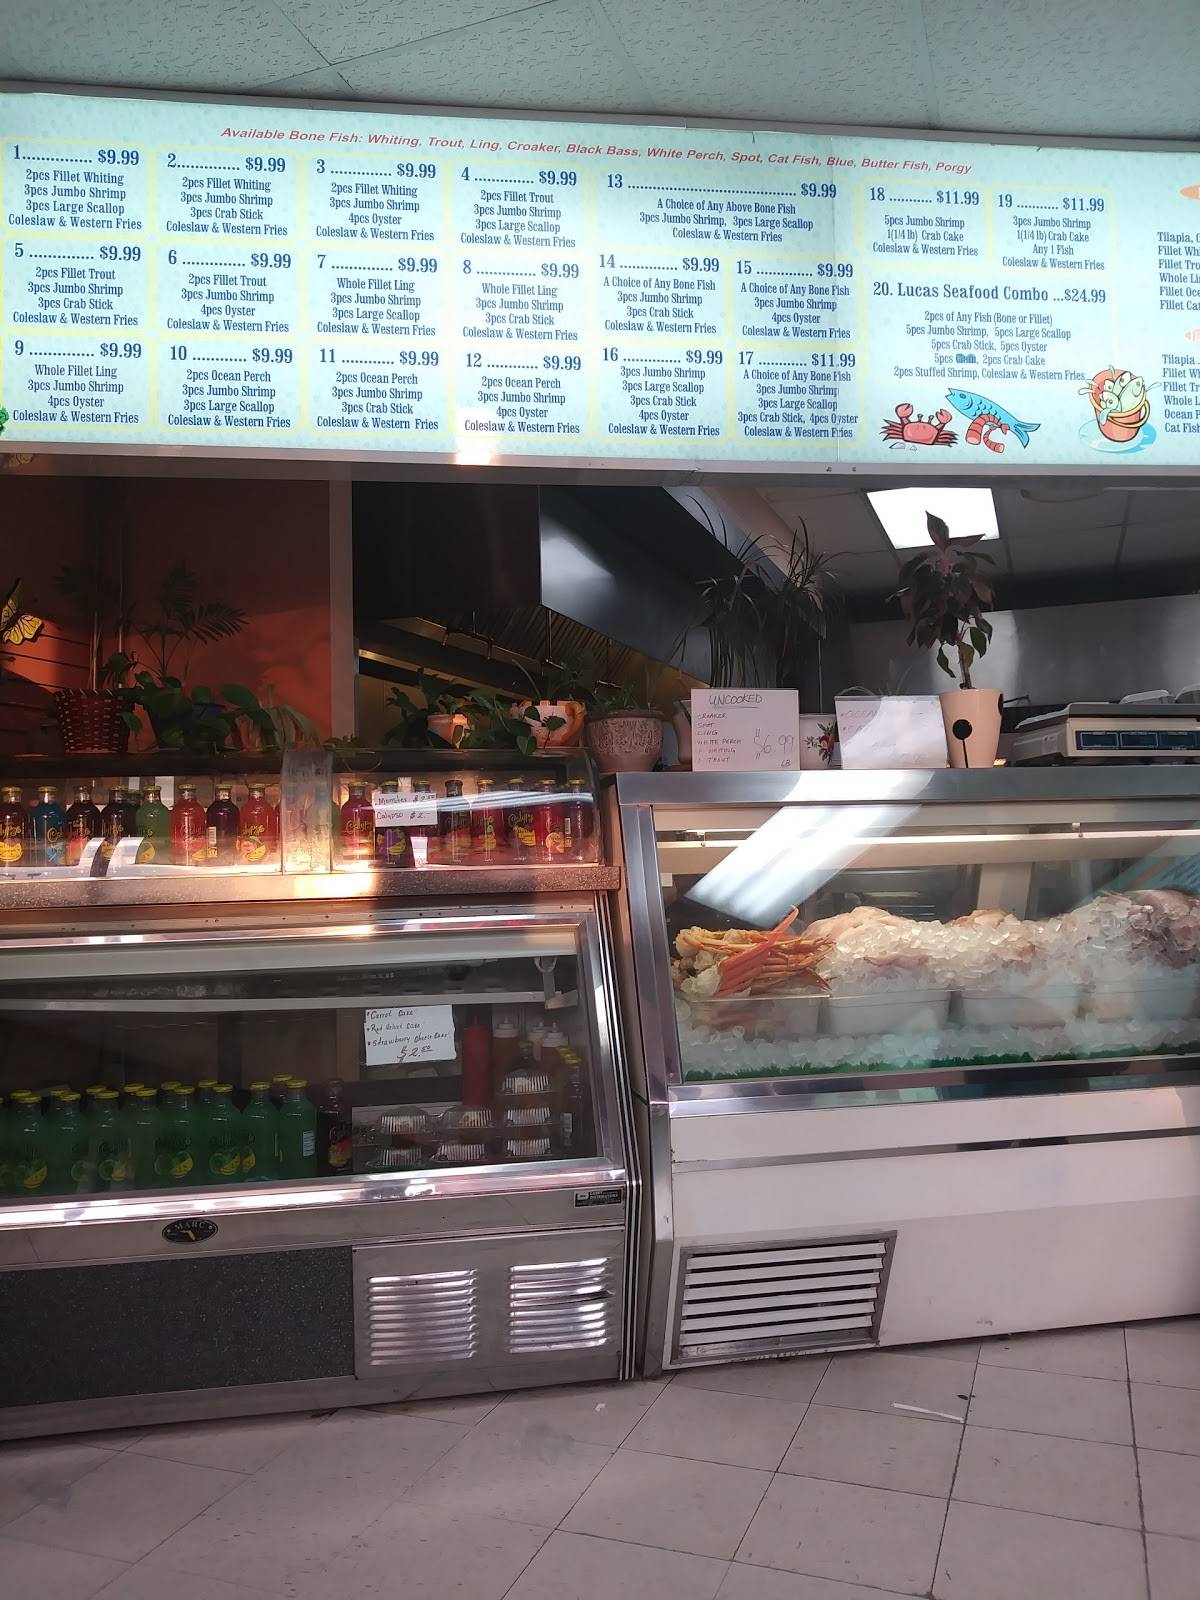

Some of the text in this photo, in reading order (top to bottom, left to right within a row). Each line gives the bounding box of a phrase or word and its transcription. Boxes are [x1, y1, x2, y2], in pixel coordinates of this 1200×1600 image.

[97, 148, 139, 165] $9.99
[219, 127, 972, 175] Available Bone Fish: Whiting, Trout, Ling, Croaker, Black Bass, White Perch, Spot, Cat Fish, Blue, Butter Fish, Porgy
[245, 156, 285, 172] $9.99
[396, 162, 436, 178] $9.99
[25, 168, 124, 186] 2pcs Fillet Whiting
[538, 169, 577, 186] $9.99
[24, 183, 126, 201] 3pcs Jumbo Shrimp
[800, 181, 836, 199] $9.99
[936, 189, 979, 205] $11.99
[25, 198, 124, 216] 3pcs Large Scallop
[657, 197, 795, 214] A Choice of Any Above Bone Fish
[1062, 196, 1104, 212] $11.99
[8, 213, 141, 229] Coleslaw & Western Fries
[884, 214, 964, 230] 5pcs Jumbo Shrimp
[1157, 231, 1193, 244] Tilapia,
[99, 245, 141, 261] $9.99
[872, 239, 978, 256] Coleslaw & Western Fries
[1158, 244, 1182, 256] Fillet
[250, 252, 291, 268] $9.99
[398, 257, 437, 273] $9.99
[682, 256, 719, 272] $9.99
[1158, 258, 1182, 270] Fillet
[540, 262, 579, 278] $9.99
[817, 262, 853, 278] $9.99
[1159, 272, 1188, 283] Whole
[188, 272, 267, 287] 2pcs Fillet Trout
[897, 282, 939, 297] Lucas
[943, 283, 999, 299] Seafood
[1003, 286, 1048, 301] Combo
[1159, 285, 1183, 296] Fillet
[37, 296, 113, 311] 3pcs Crab Stick
[1159, 299, 1184, 310] Fillet
[332, 306, 419, 322] 3pcs Large Scallop
[924, 310, 1052, 328] 2pcs of Any Fish (Bone or Fillet)
[99, 342, 141, 358] $9.99
[252, 347, 293, 363] $9.99
[685, 349, 722, 364] $9.99
[543, 355, 581, 371] $9.99
[811, 352, 855, 367] $11.99
[1161, 353, 1195, 366] Tilapia
[35, 363, 117, 379] Whole Fillet Ling
[186, 368, 271, 383] 2pcs Ocean Perch
[893, 365, 1088, 384] 2pcs Stuffed Shrimp, Coleslaw & Western Fries
[1162, 367, 1186, 378] Fillet
[1163, 381, 1187, 392] Fillet
[47, 394, 104, 412] 4pcs Oyster
[1164, 394, 1192, 406] Whole
[1164, 408, 1193, 419] Ocean
[1164, 422, 1181, 433] Cat
[708, 694, 763, 706] UNCOOKED
